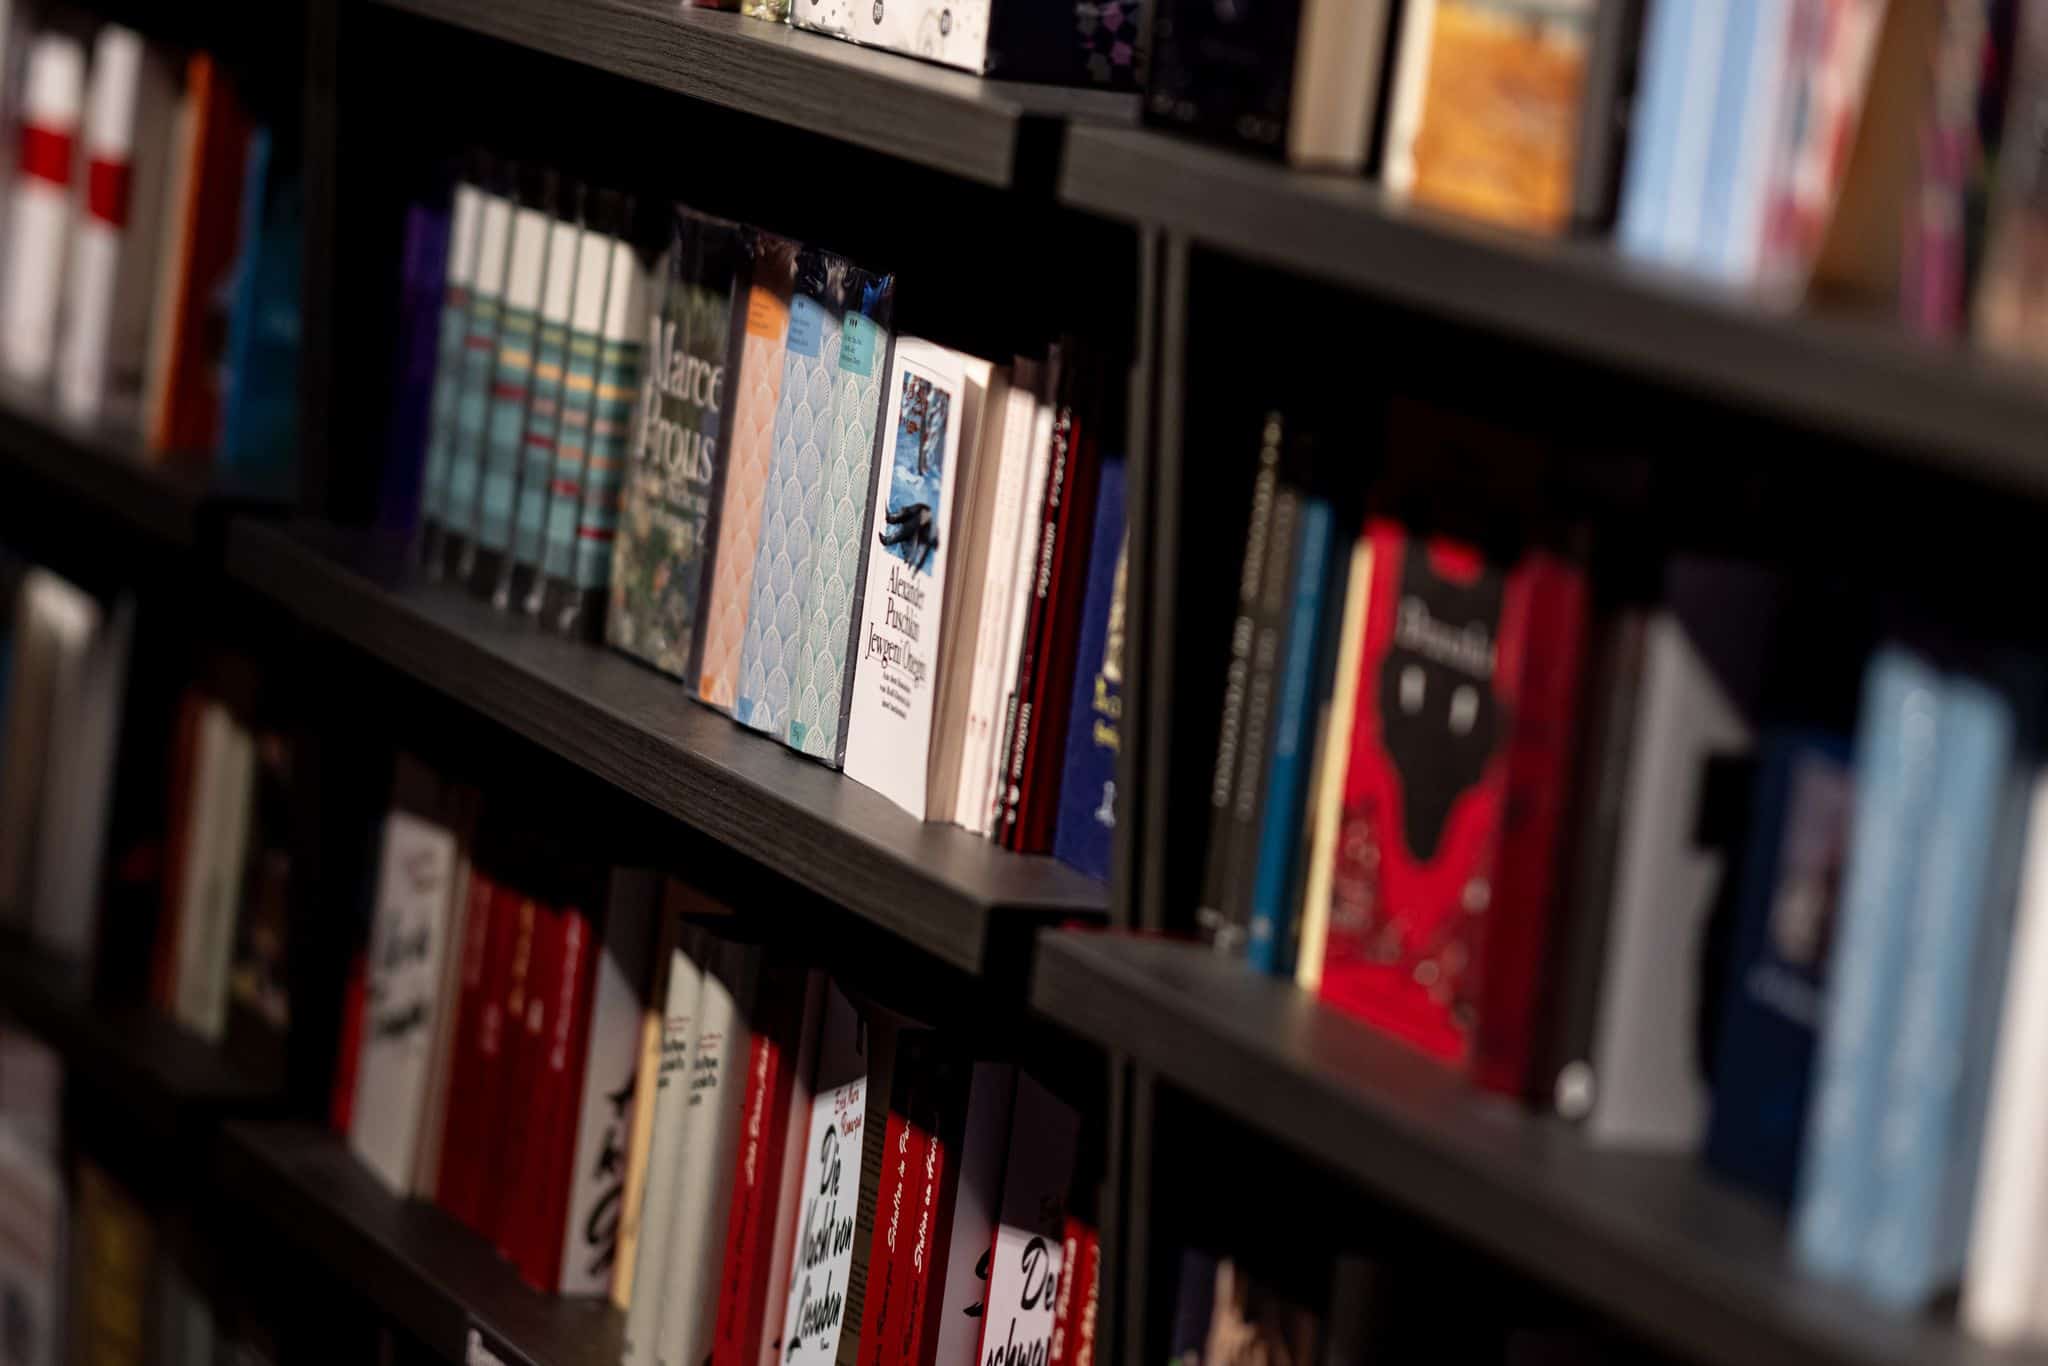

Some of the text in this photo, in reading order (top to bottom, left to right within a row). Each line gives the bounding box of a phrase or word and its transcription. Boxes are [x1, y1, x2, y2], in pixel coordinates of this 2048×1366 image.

[650, 315, 724, 412] Marce
[639, 376, 715, 486] Prous
[820, 1123, 842, 1197] Die
[833, 1215, 853, 1257] von
